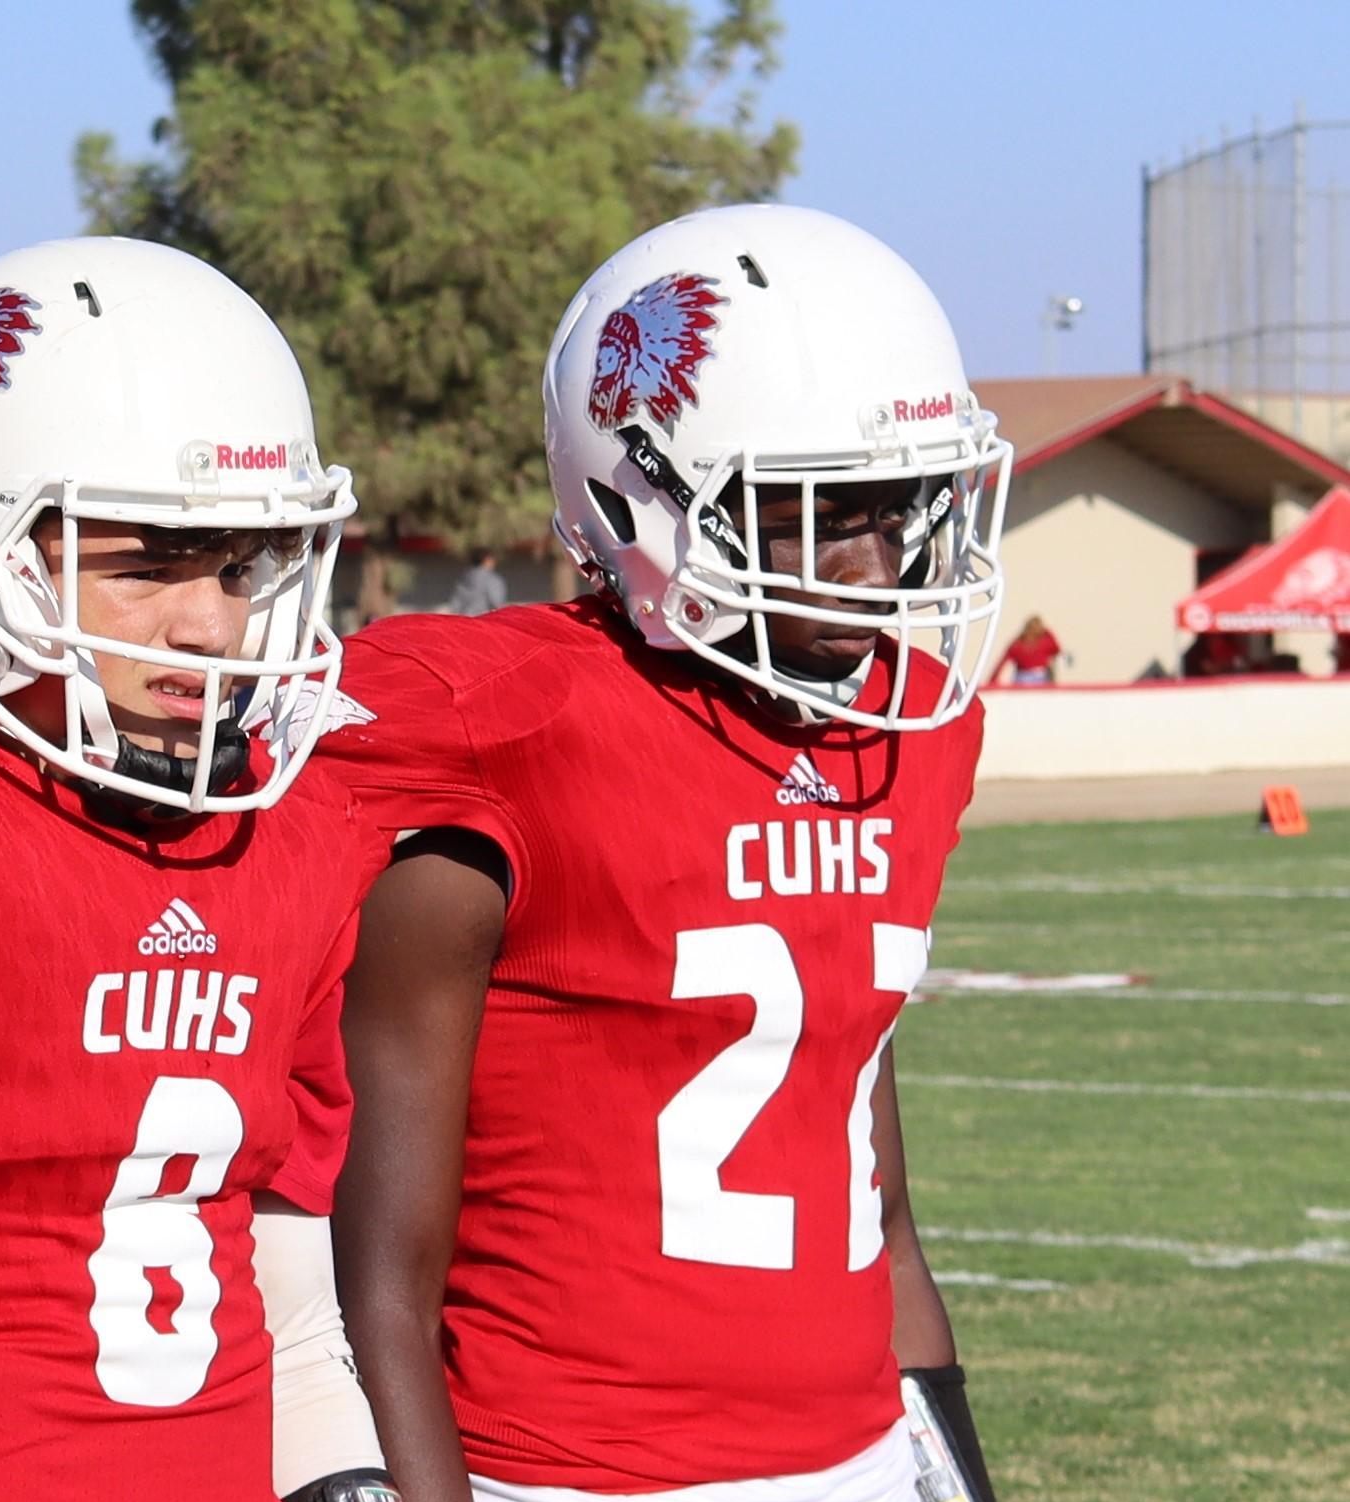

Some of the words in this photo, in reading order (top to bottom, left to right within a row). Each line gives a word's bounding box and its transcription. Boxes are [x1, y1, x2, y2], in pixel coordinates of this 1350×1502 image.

[893, 392, 954, 422] Riddell
[216, 444, 287, 469] Riddell
[776, 783, 841, 805] adidas
[727, 818, 893, 900] CUHS
[137, 929, 218, 956] adidas
[82, 969, 259, 1056] CUHS
[87, 1075, 244, 1408] 8
